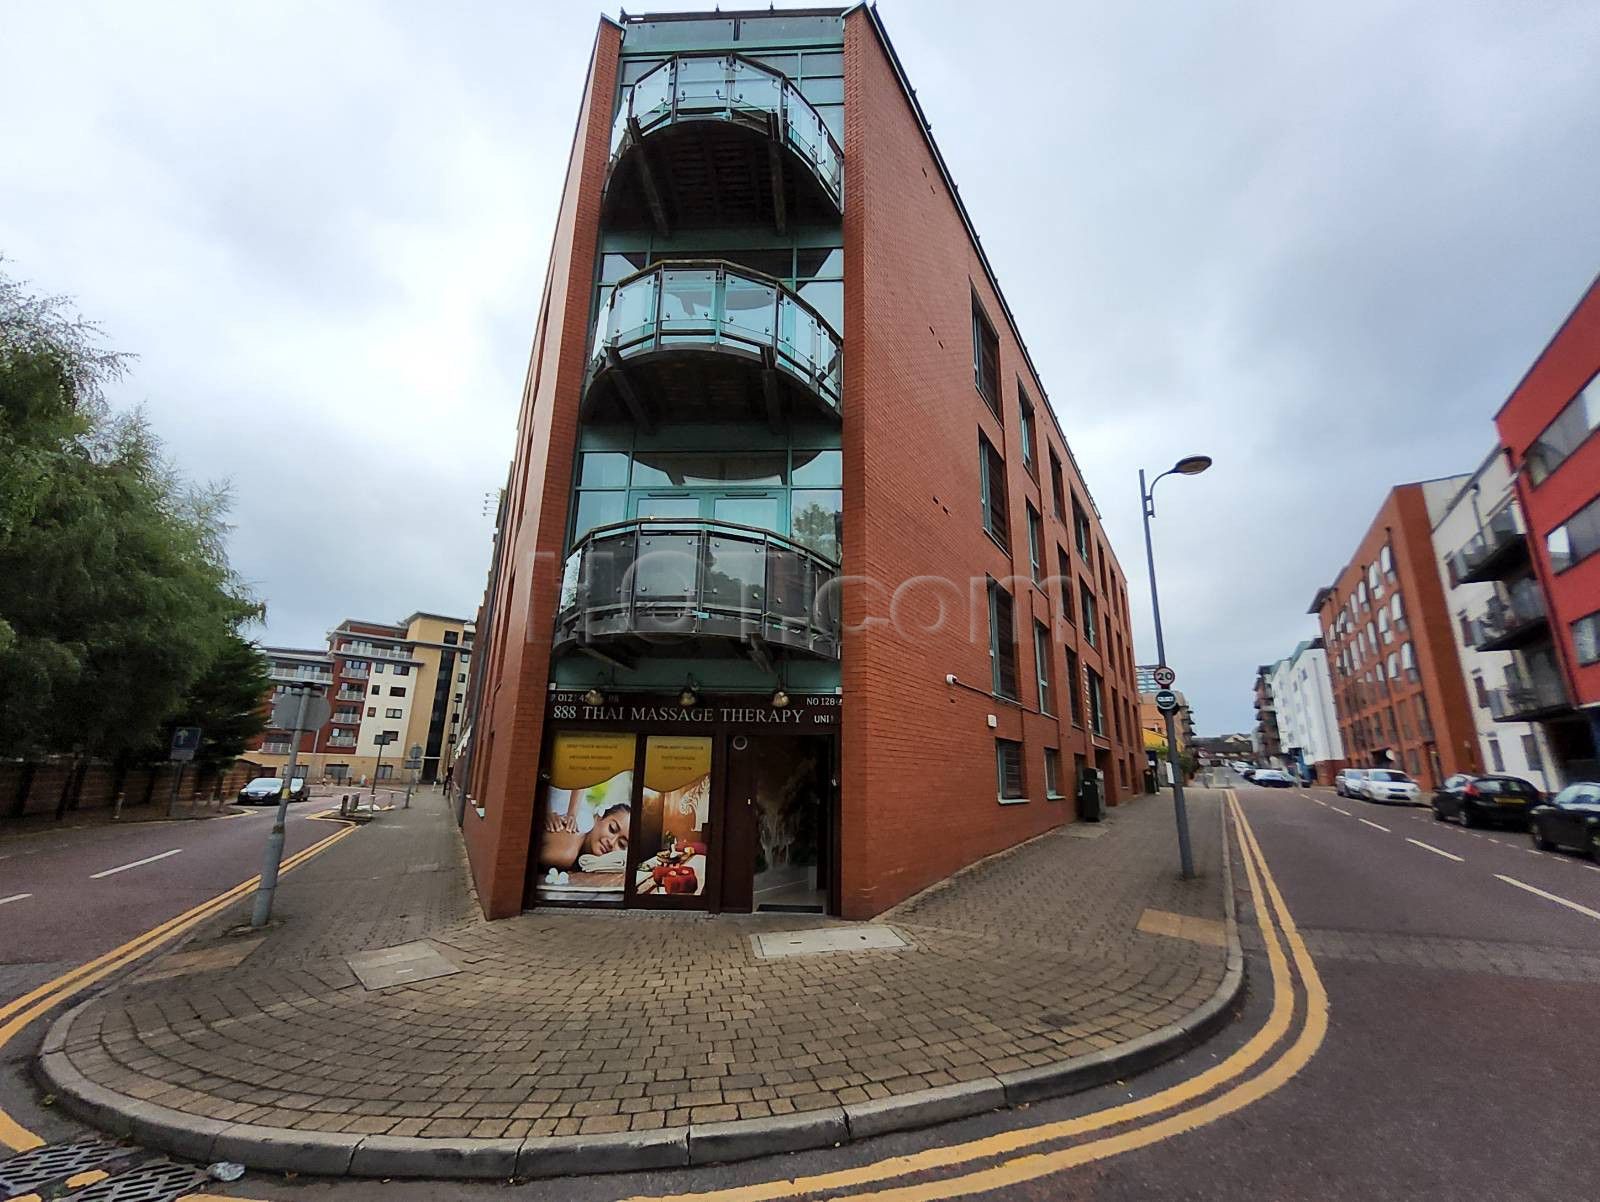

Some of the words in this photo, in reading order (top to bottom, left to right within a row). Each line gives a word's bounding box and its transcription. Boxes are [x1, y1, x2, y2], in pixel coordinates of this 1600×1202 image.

[1157, 672, 1173, 681] 20
[806, 697, 819, 706] NO
[553, 705, 577, 719] 888
[582, 706, 624, 720] THAI
[631, 707, 714, 722] MASSAGE
[720, 708, 804, 723] THERAPY
